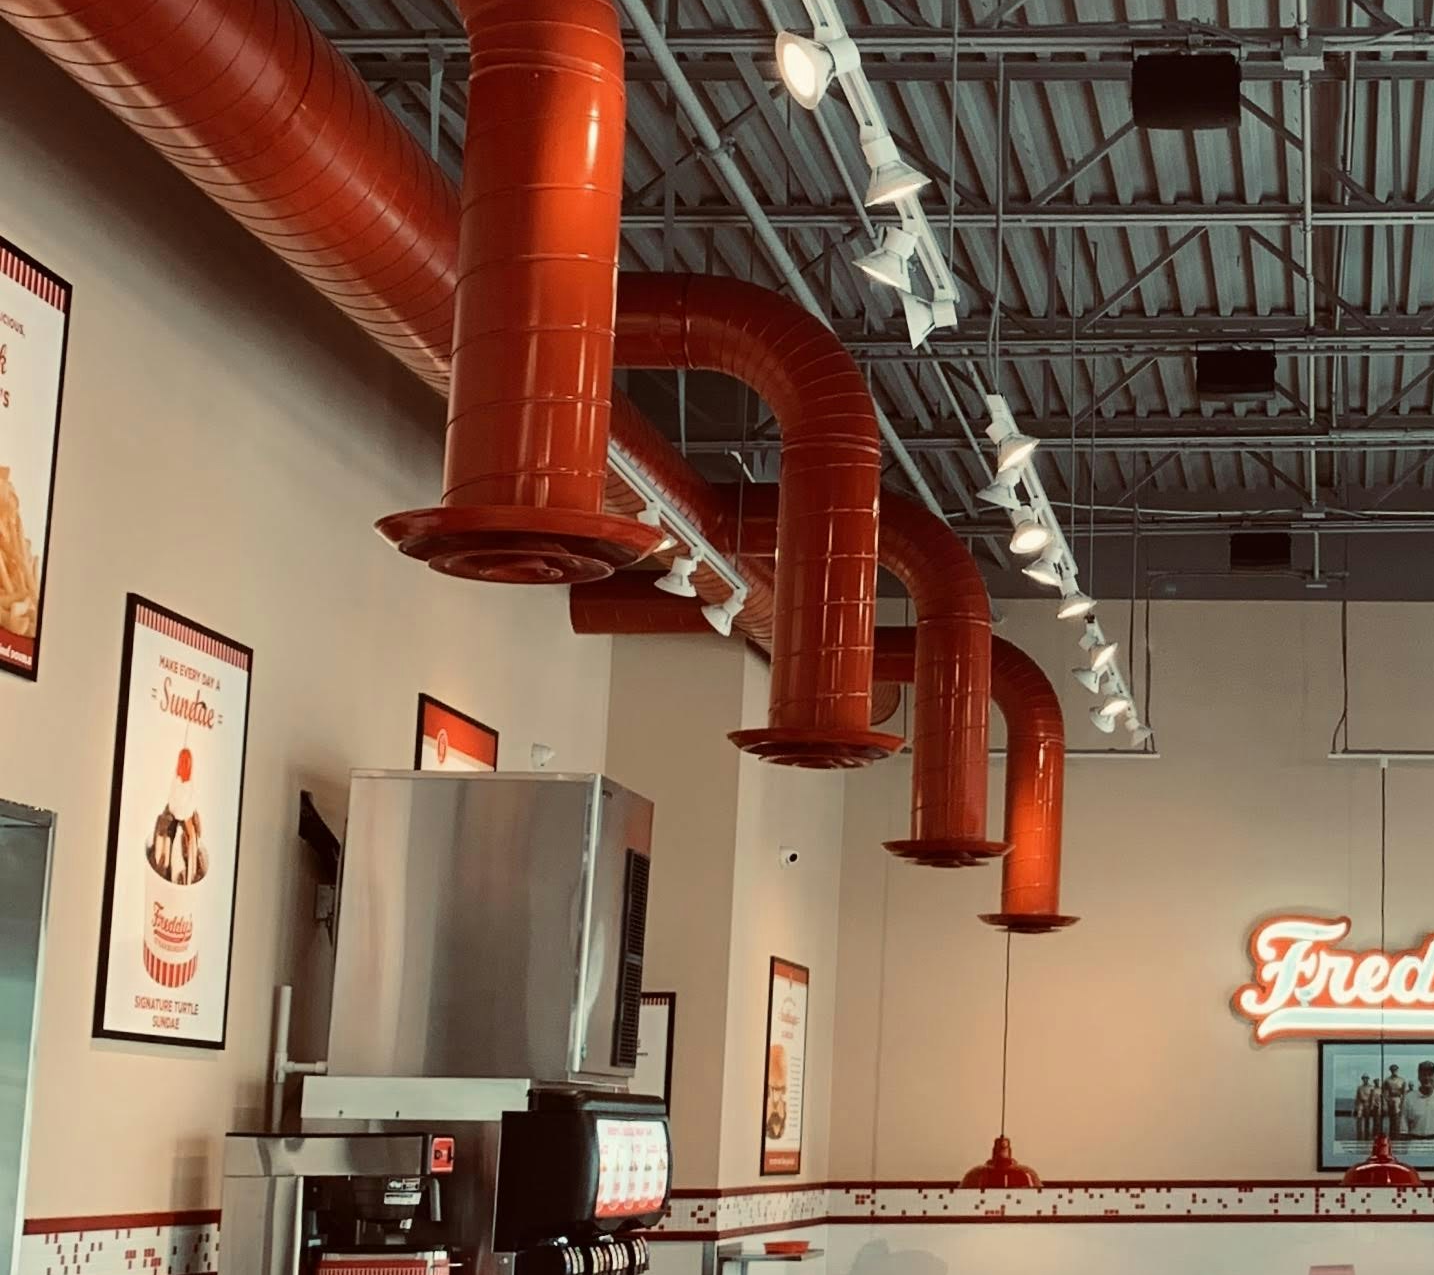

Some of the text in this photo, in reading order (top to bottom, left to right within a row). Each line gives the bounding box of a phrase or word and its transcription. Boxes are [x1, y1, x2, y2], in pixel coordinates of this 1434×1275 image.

[159, 655, 221, 691] MAKE EVERY DAY A
[160, 676, 215, 729] Sundae
[152, 901, 192, 943] Freddy's
[134, 995, 199, 1016] SIGNATURE TURTLE
[152, 1015, 179, 1030] SUNDAE
